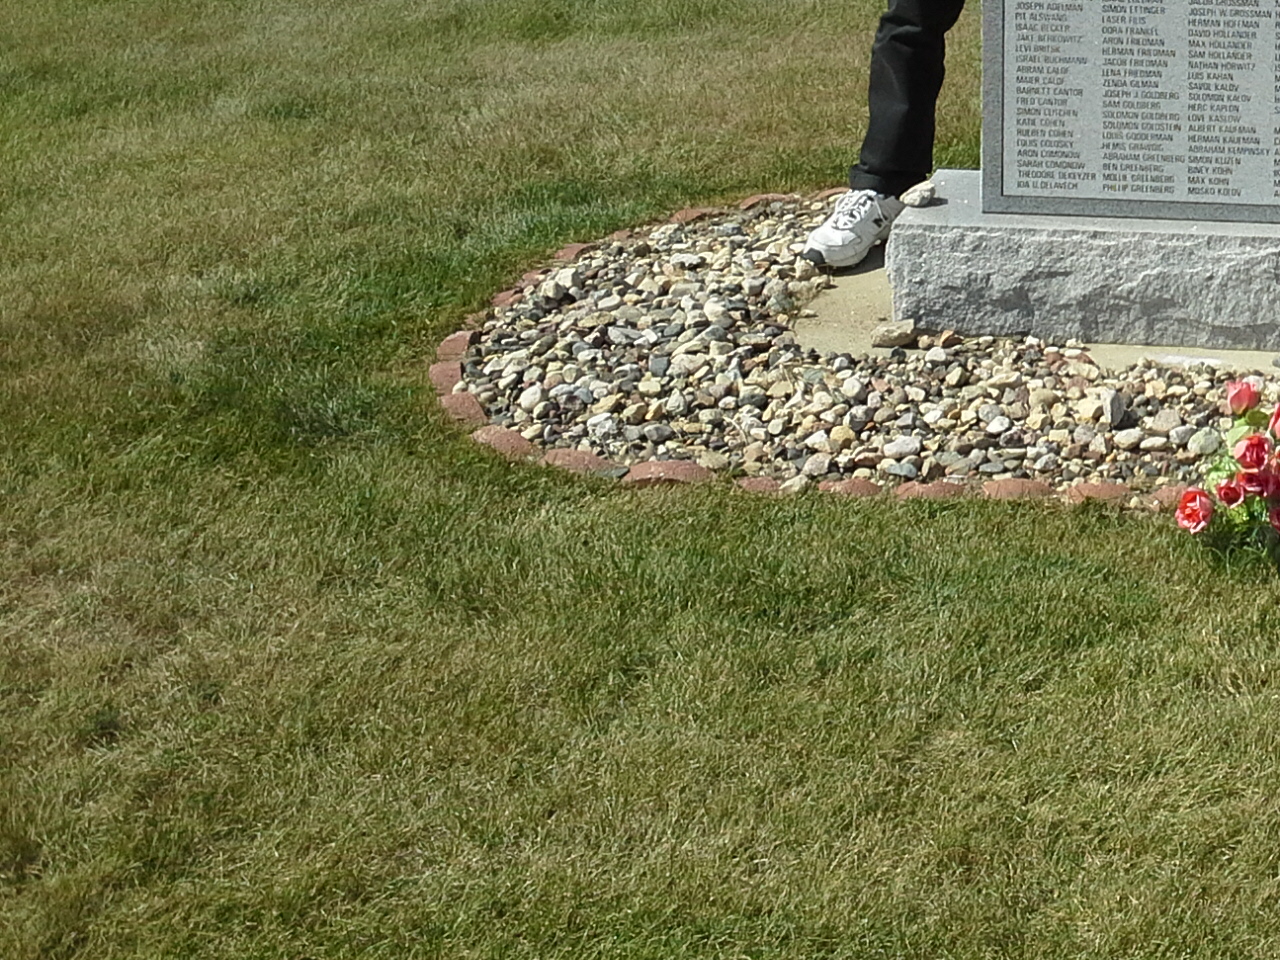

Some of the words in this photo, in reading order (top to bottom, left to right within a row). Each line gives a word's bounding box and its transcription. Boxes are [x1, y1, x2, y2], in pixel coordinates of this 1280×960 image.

[1015, 2, 1044, 10] JOSEPH
[1102, 5, 1127, 13] SIMON
[1188, 62, 1218, 70] NATHAN
[1040, 119, 1065, 127] COHEN
[1188, 146, 1225, 154] ABRAHAM
